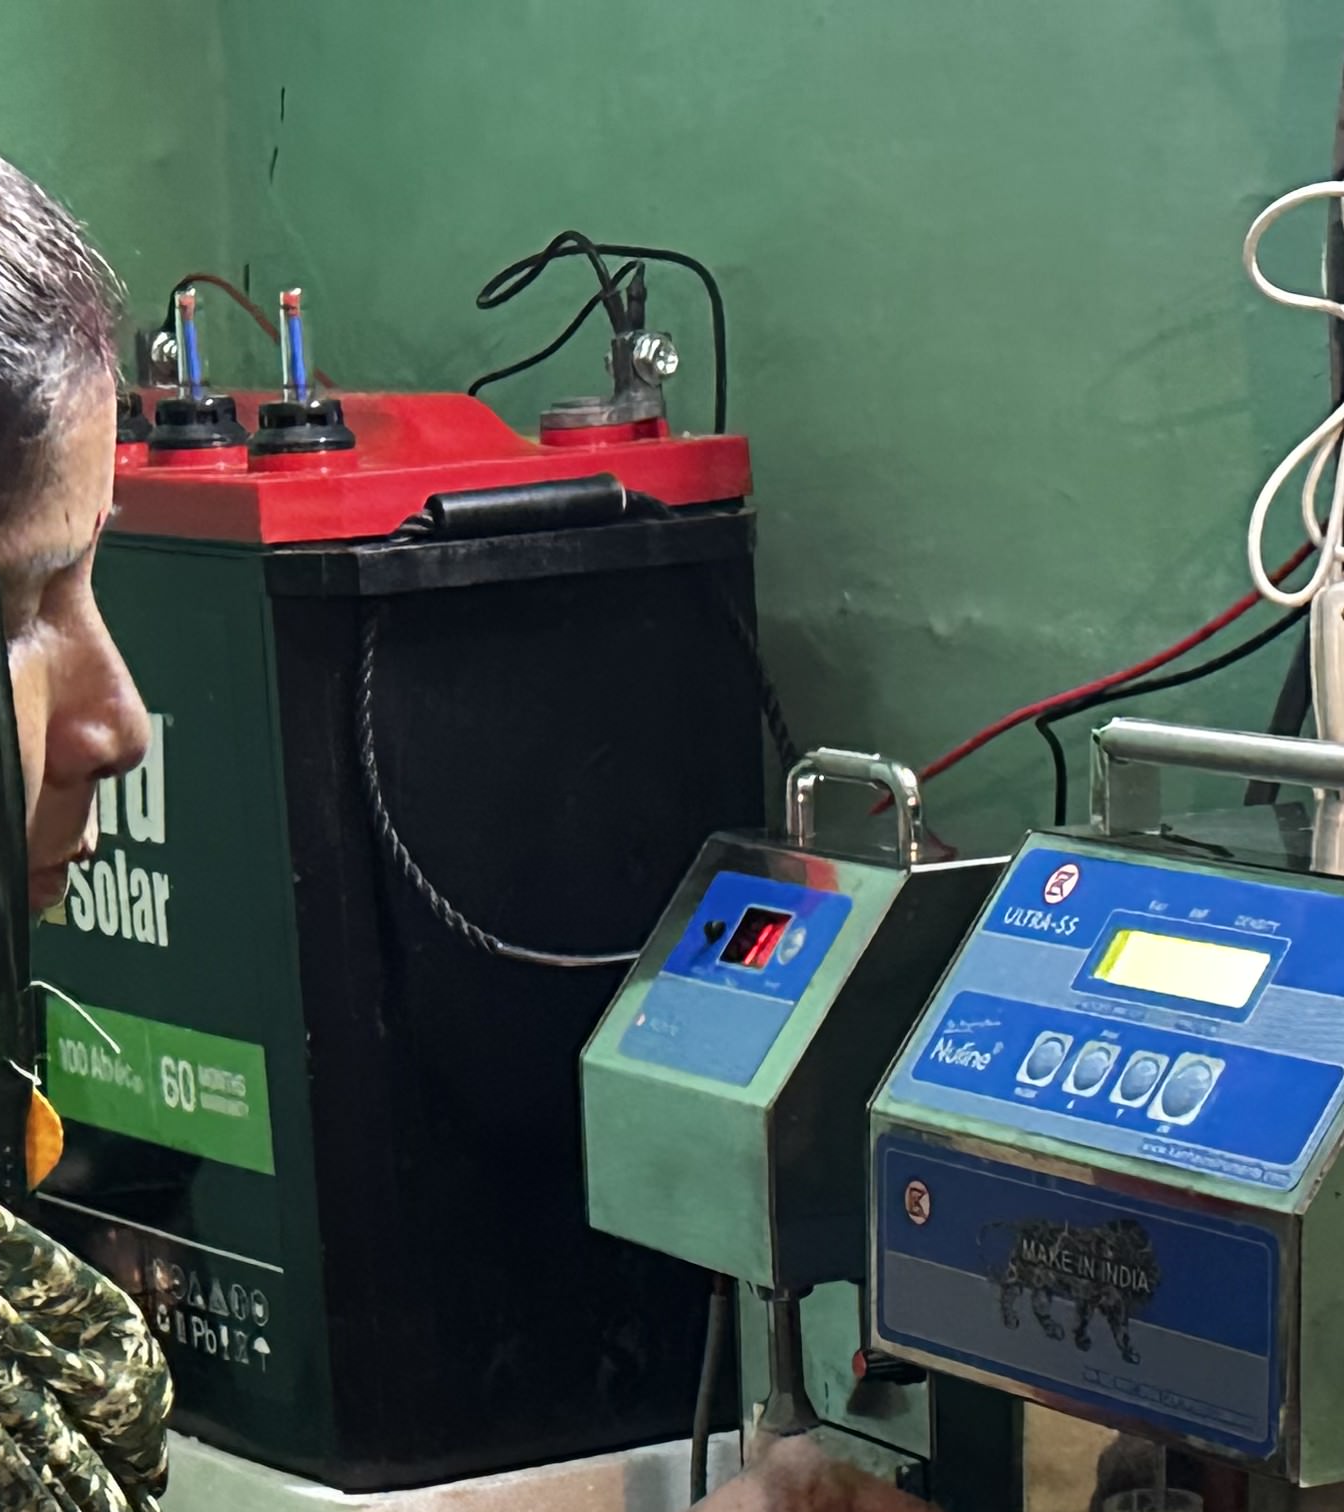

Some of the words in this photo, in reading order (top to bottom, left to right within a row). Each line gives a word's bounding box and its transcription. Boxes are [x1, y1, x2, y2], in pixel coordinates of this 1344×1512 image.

[160, 1056, 196, 1112] 60
[1022, 1238, 1073, 1273] MAKE
[1078, 1255, 1096, 1279] IN
[1102, 1261, 1151, 1293] INDIA
[191, 1315, 217, 1354] Pb
